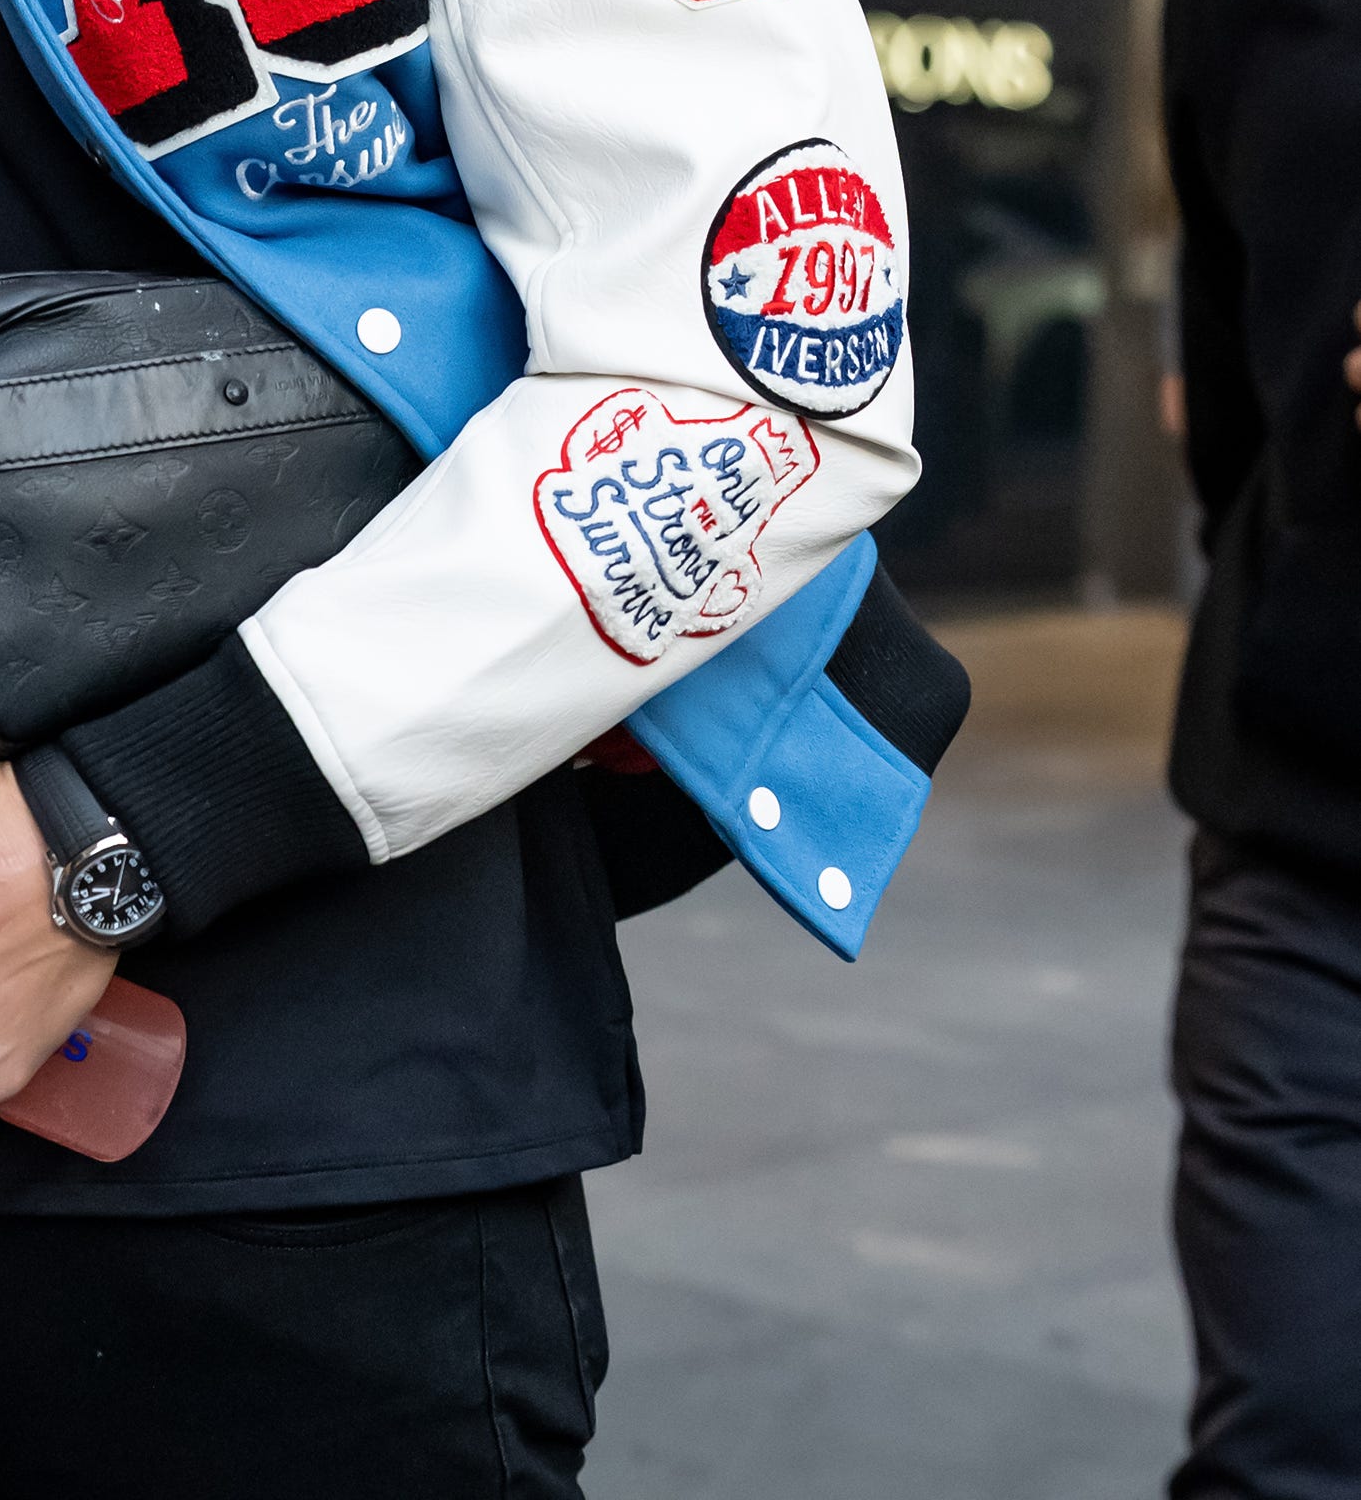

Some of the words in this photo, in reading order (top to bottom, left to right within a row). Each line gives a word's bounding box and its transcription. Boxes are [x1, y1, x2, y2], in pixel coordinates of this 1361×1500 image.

[272, 83, 377, 165] The
[756, 174, 866, 244] ALLEN
[759, 240, 875, 317] 1997
[748, 322, 890, 384] IVERSON
[620, 447, 720, 600] Strong
[690, 497, 718, 533] THE
[698, 437, 761, 542] Only
[552, 476, 673, 641] Survive
